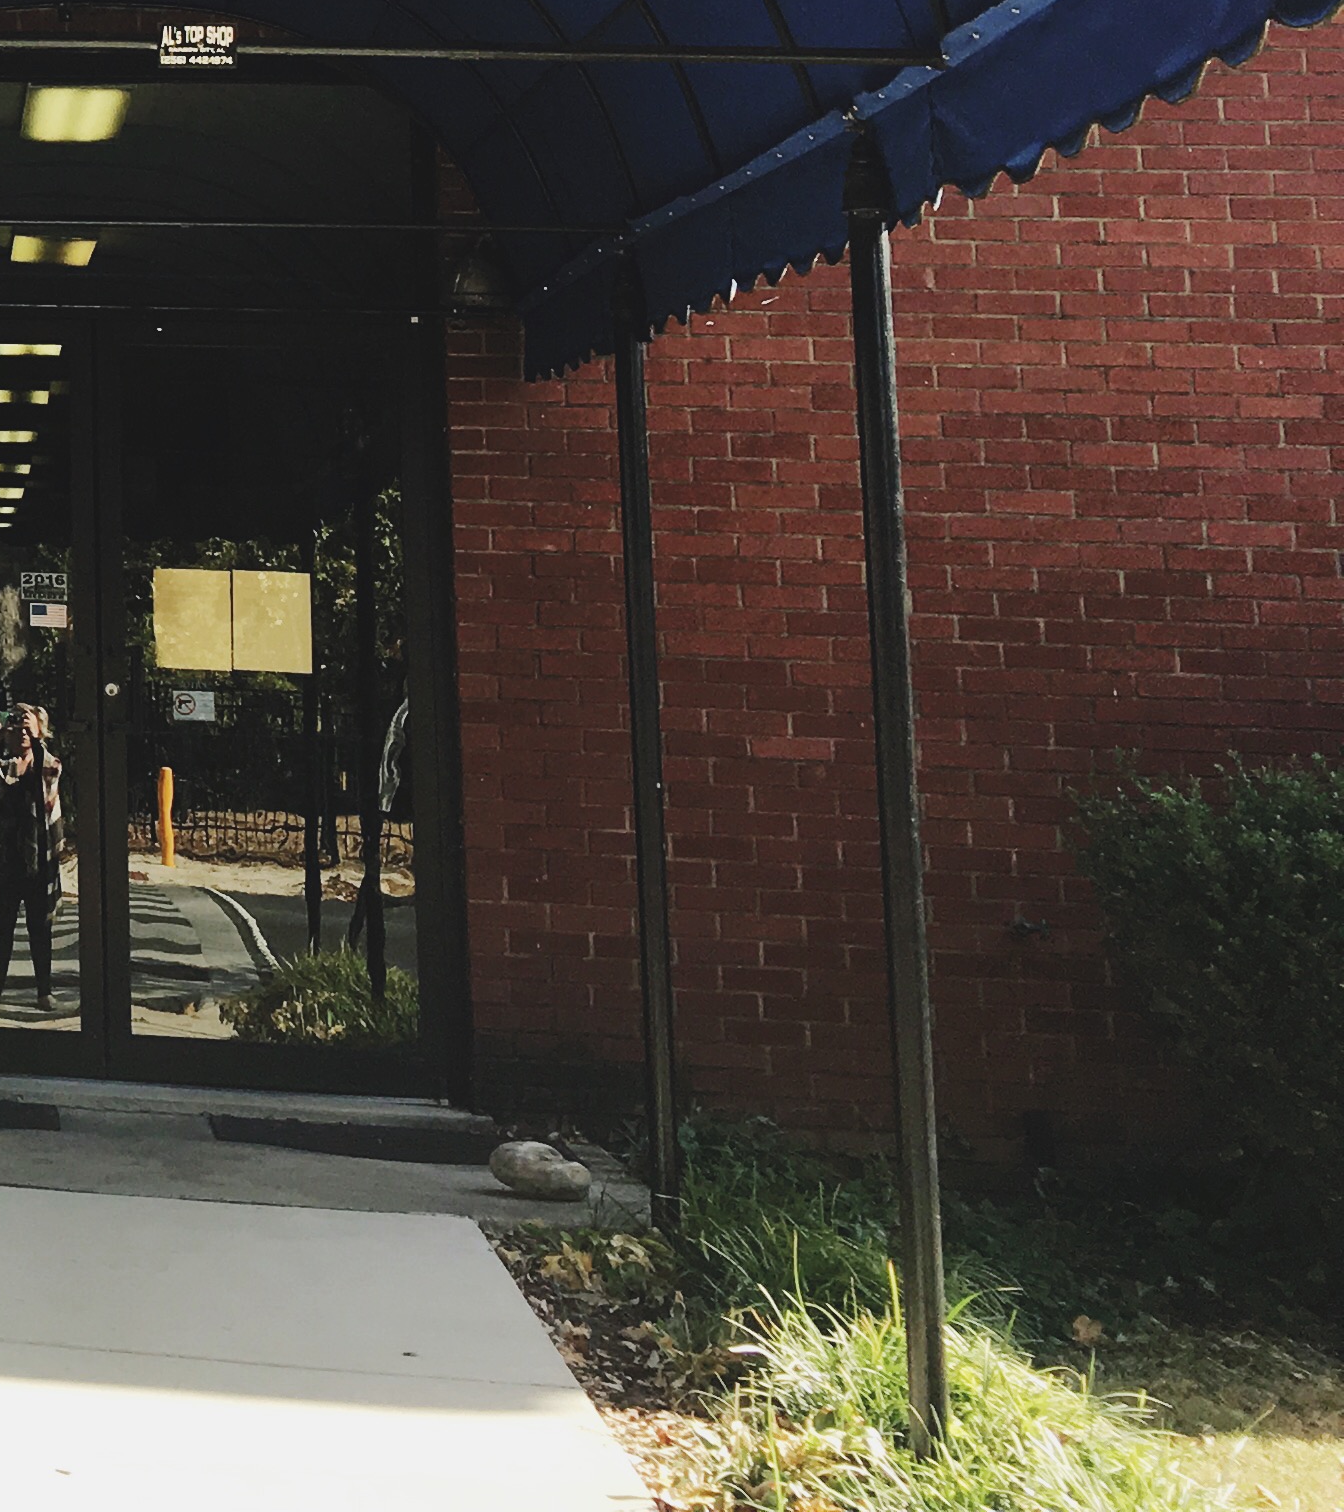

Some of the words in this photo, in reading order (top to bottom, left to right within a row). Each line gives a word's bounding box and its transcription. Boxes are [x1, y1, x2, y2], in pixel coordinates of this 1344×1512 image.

[184, 25, 205, 44] TOP
[206, 25, 234, 48] SHOP
[23, 574, 66, 586] 2016
